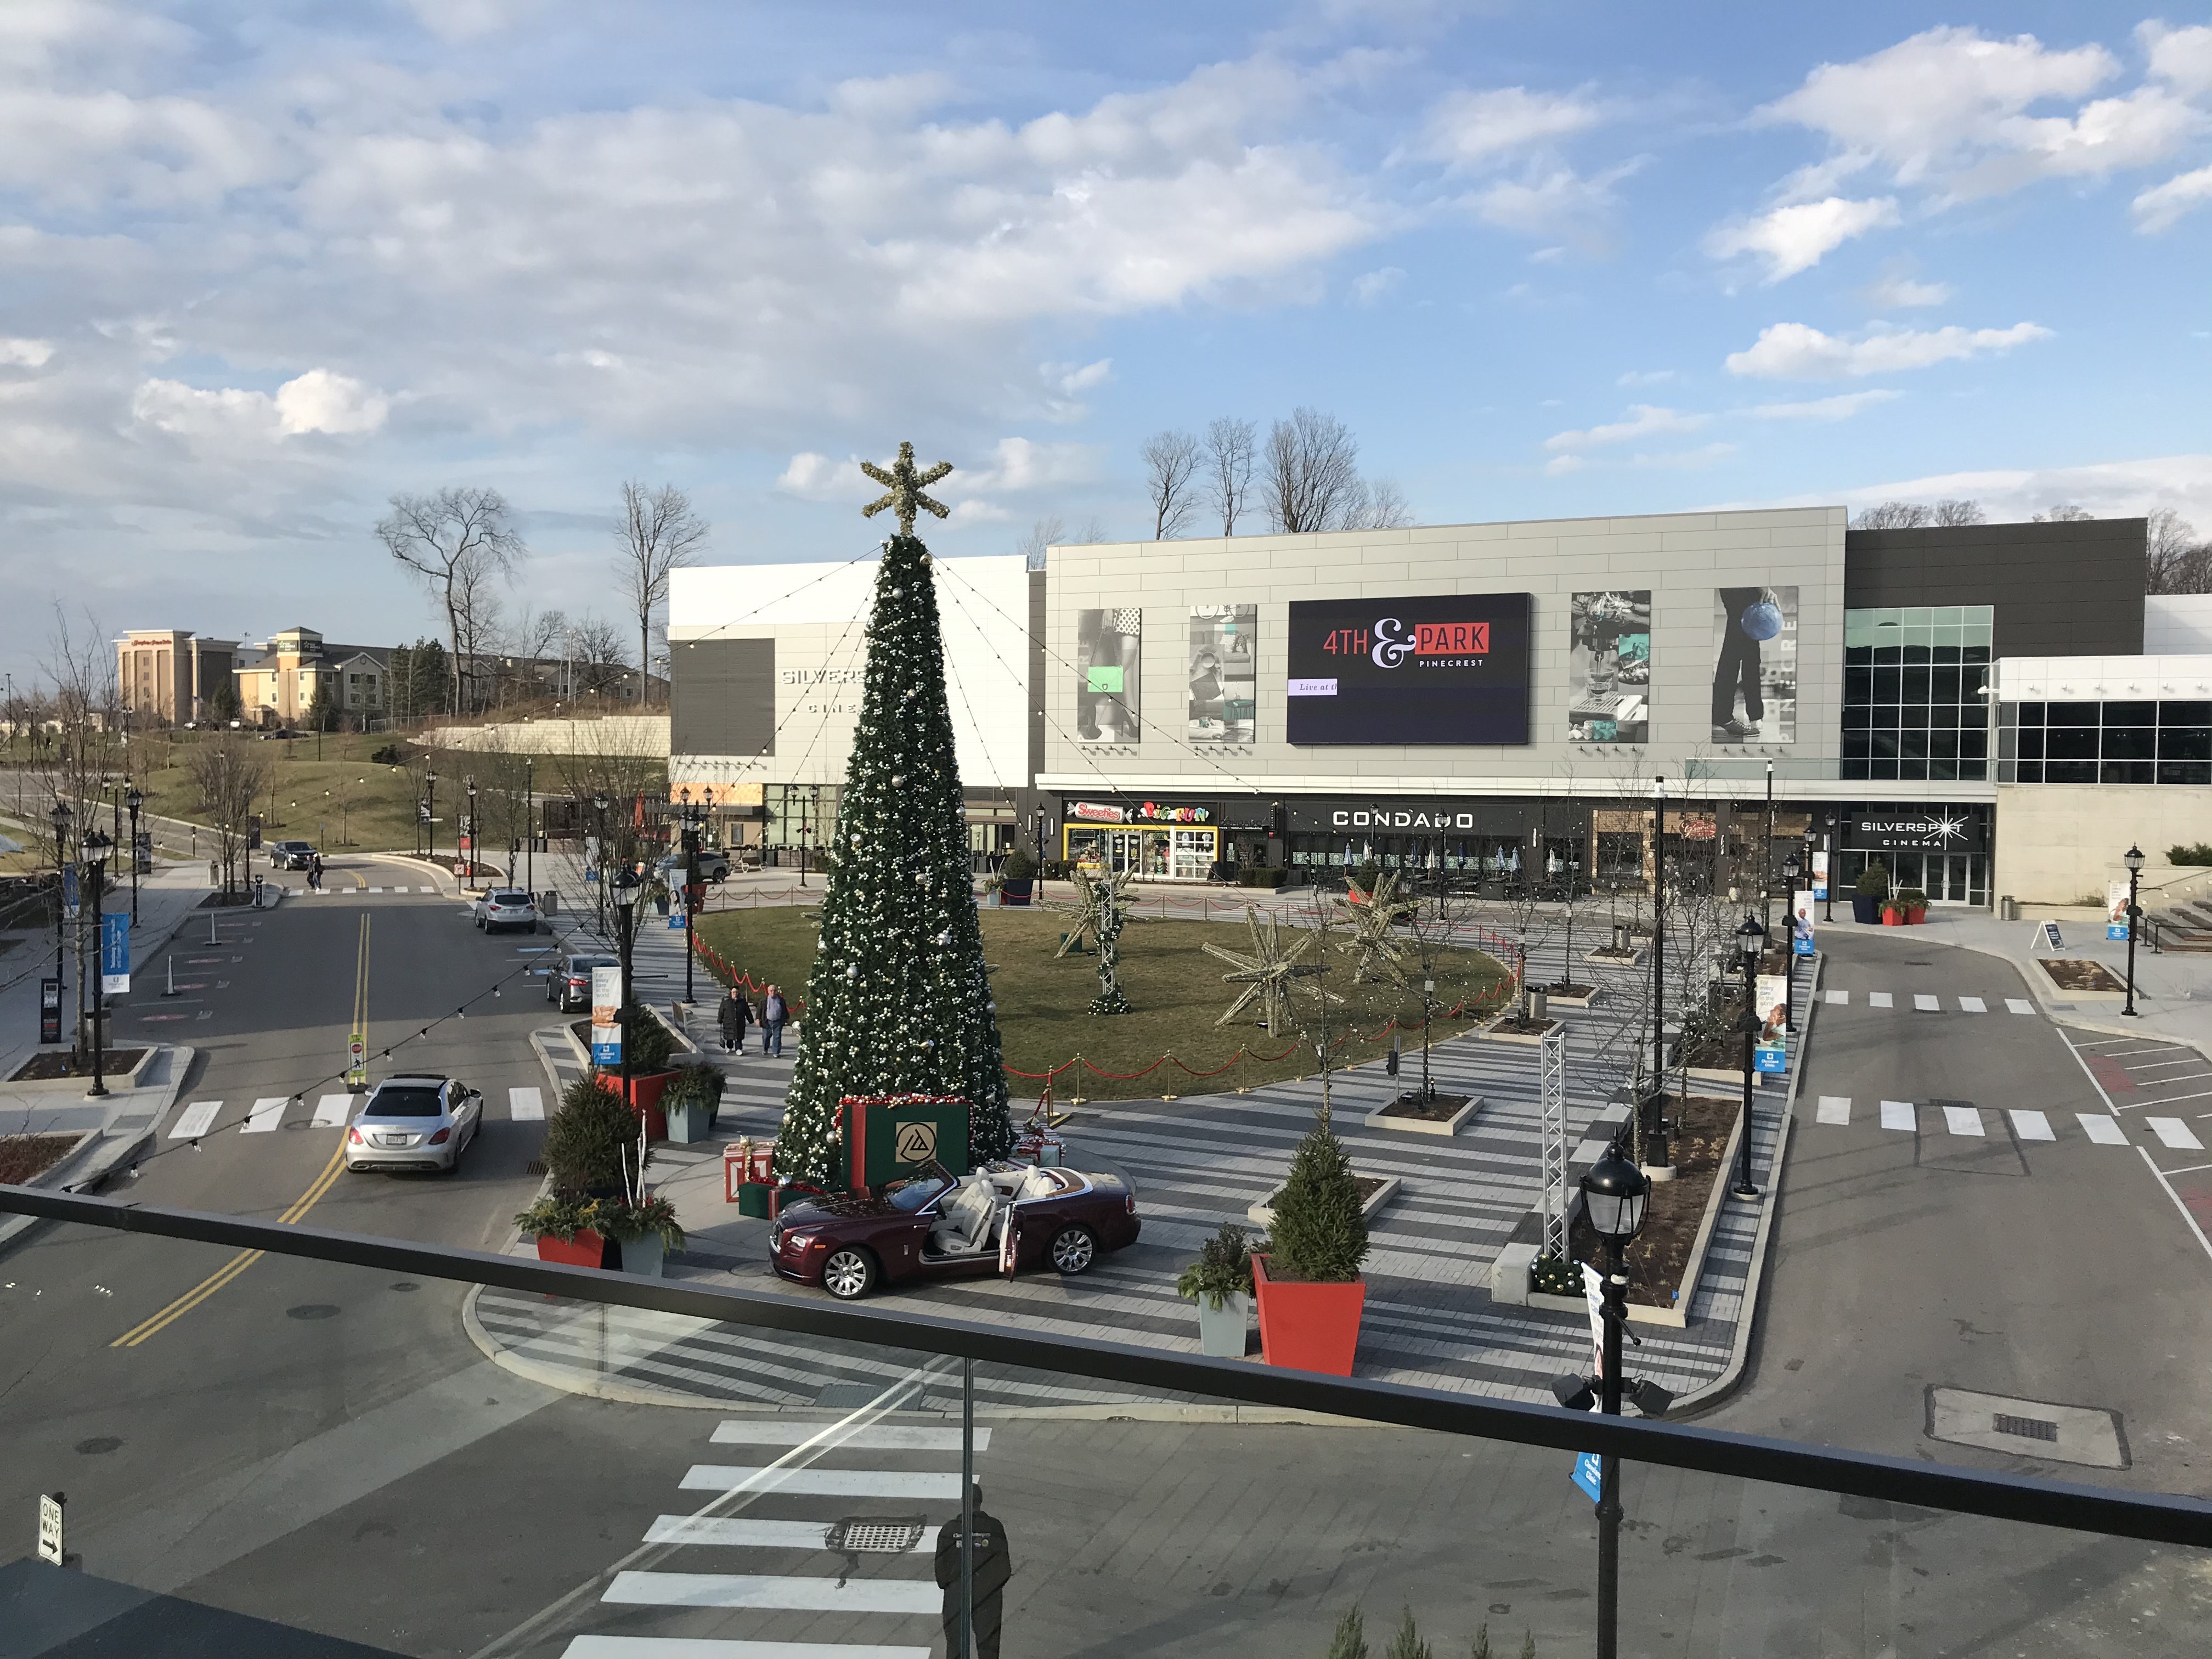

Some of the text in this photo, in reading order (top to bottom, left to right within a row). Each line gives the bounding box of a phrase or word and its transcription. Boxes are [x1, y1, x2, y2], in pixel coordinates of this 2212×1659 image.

[1323, 618, 1485, 668] 4TH & PARK
[1419, 659, 1483, 668] PINECREST
[1078, 803, 1121, 821] Sweeties
[1175, 807, 1206, 822] FUN
[1333, 811, 1474, 828] CONDADO
[43, 1503, 59, 1524] ONE
[42, 1518, 59, 1539] WAY
